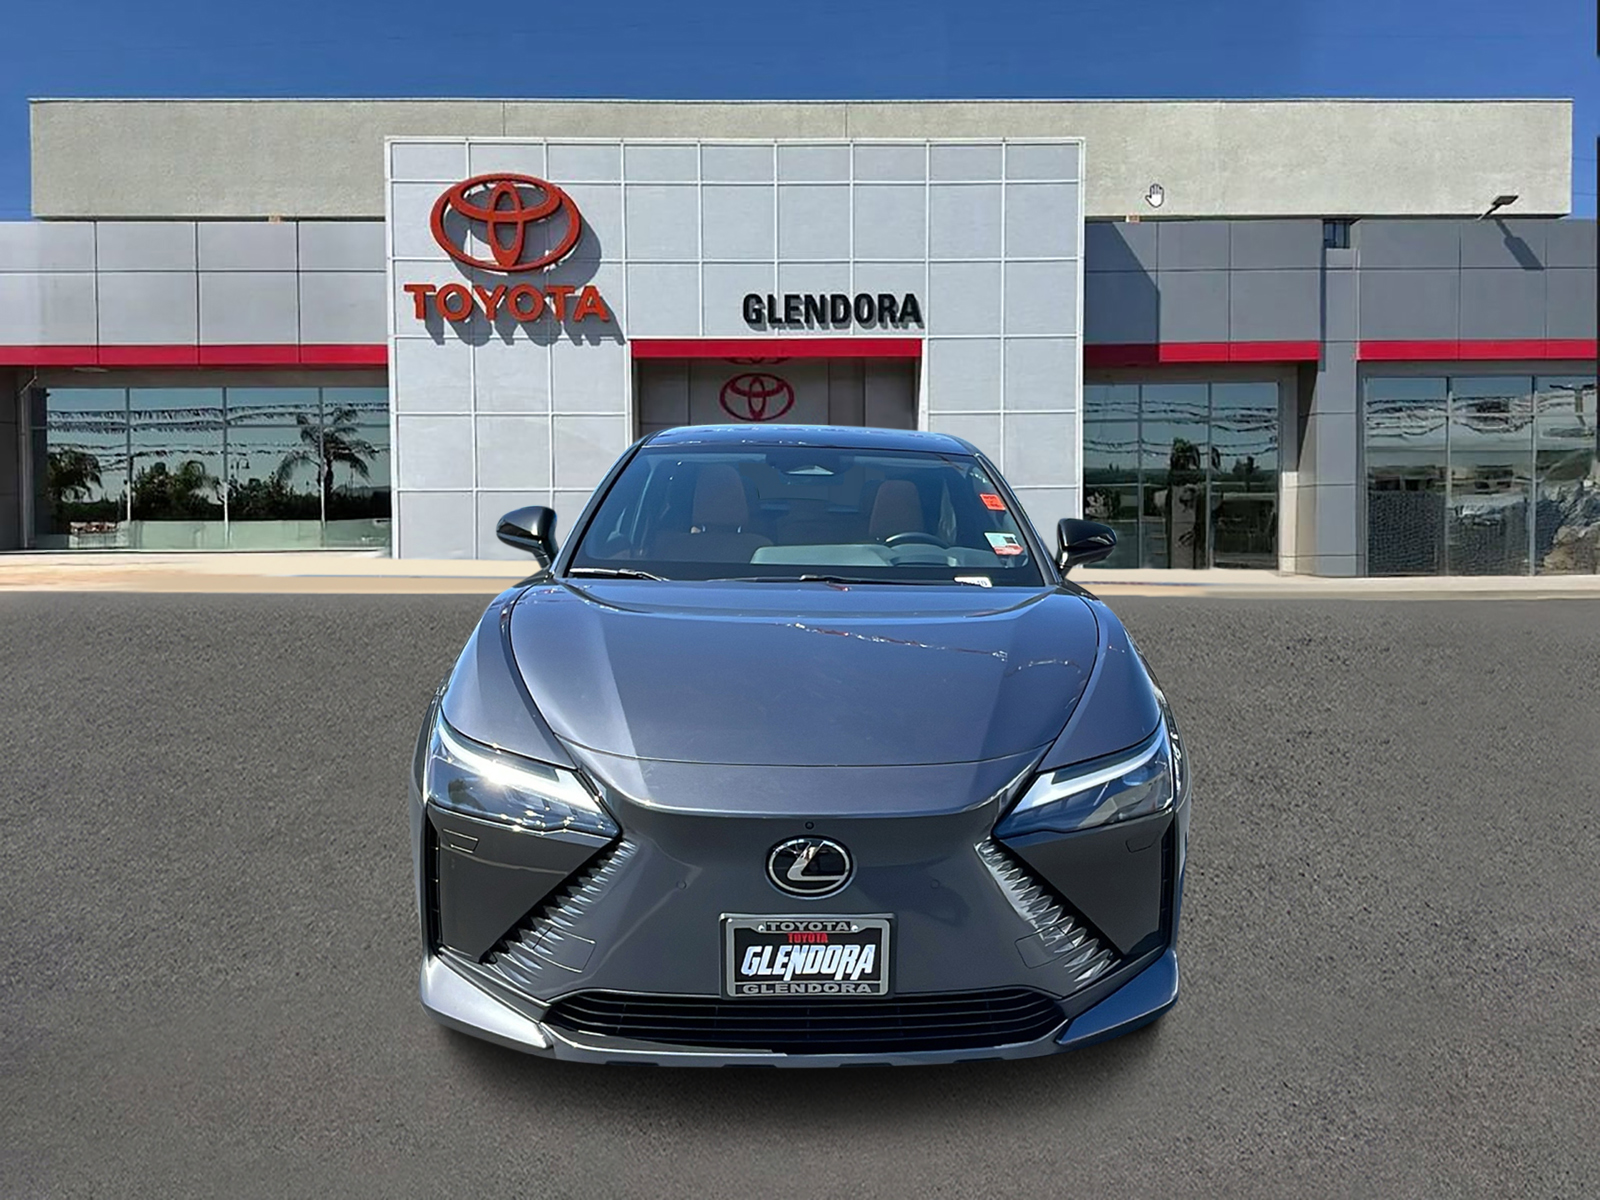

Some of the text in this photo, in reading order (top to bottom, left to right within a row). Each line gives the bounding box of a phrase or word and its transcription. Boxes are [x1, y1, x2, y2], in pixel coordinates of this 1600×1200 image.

[404, 284, 609, 323] TOYOTA
[743, 294, 923, 326] GLENDORA
[767, 922, 850, 931] TOYOTA
[788, 933, 828, 943] TOYOTA
[741, 945, 876, 981] GLENDORA
[742, 984, 872, 994] GLENDORA
